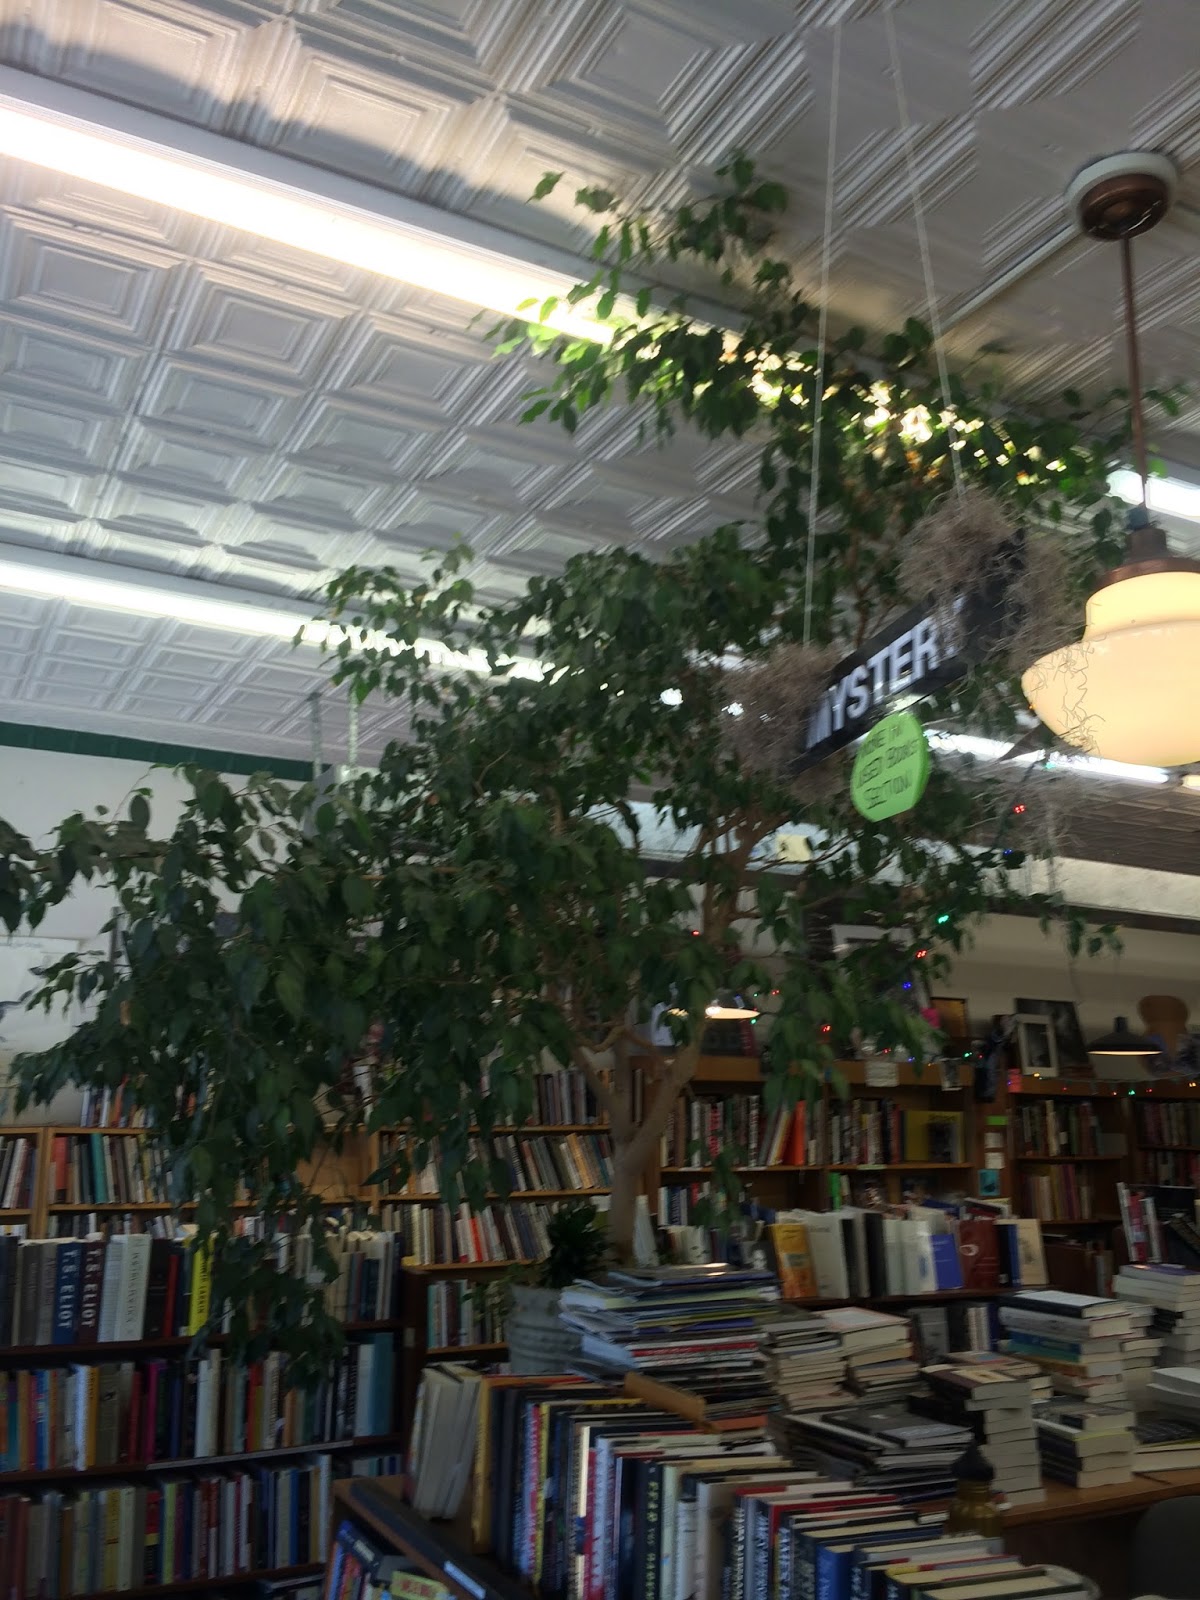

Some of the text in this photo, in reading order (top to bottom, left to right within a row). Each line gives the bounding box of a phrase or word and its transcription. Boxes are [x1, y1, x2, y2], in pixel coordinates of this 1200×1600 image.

[805, 596, 966, 750] MYSTER
[57, 1249, 78, 1330] T.S. ELIOT
[80, 1249, 102, 1329] T.S. ELIOT
